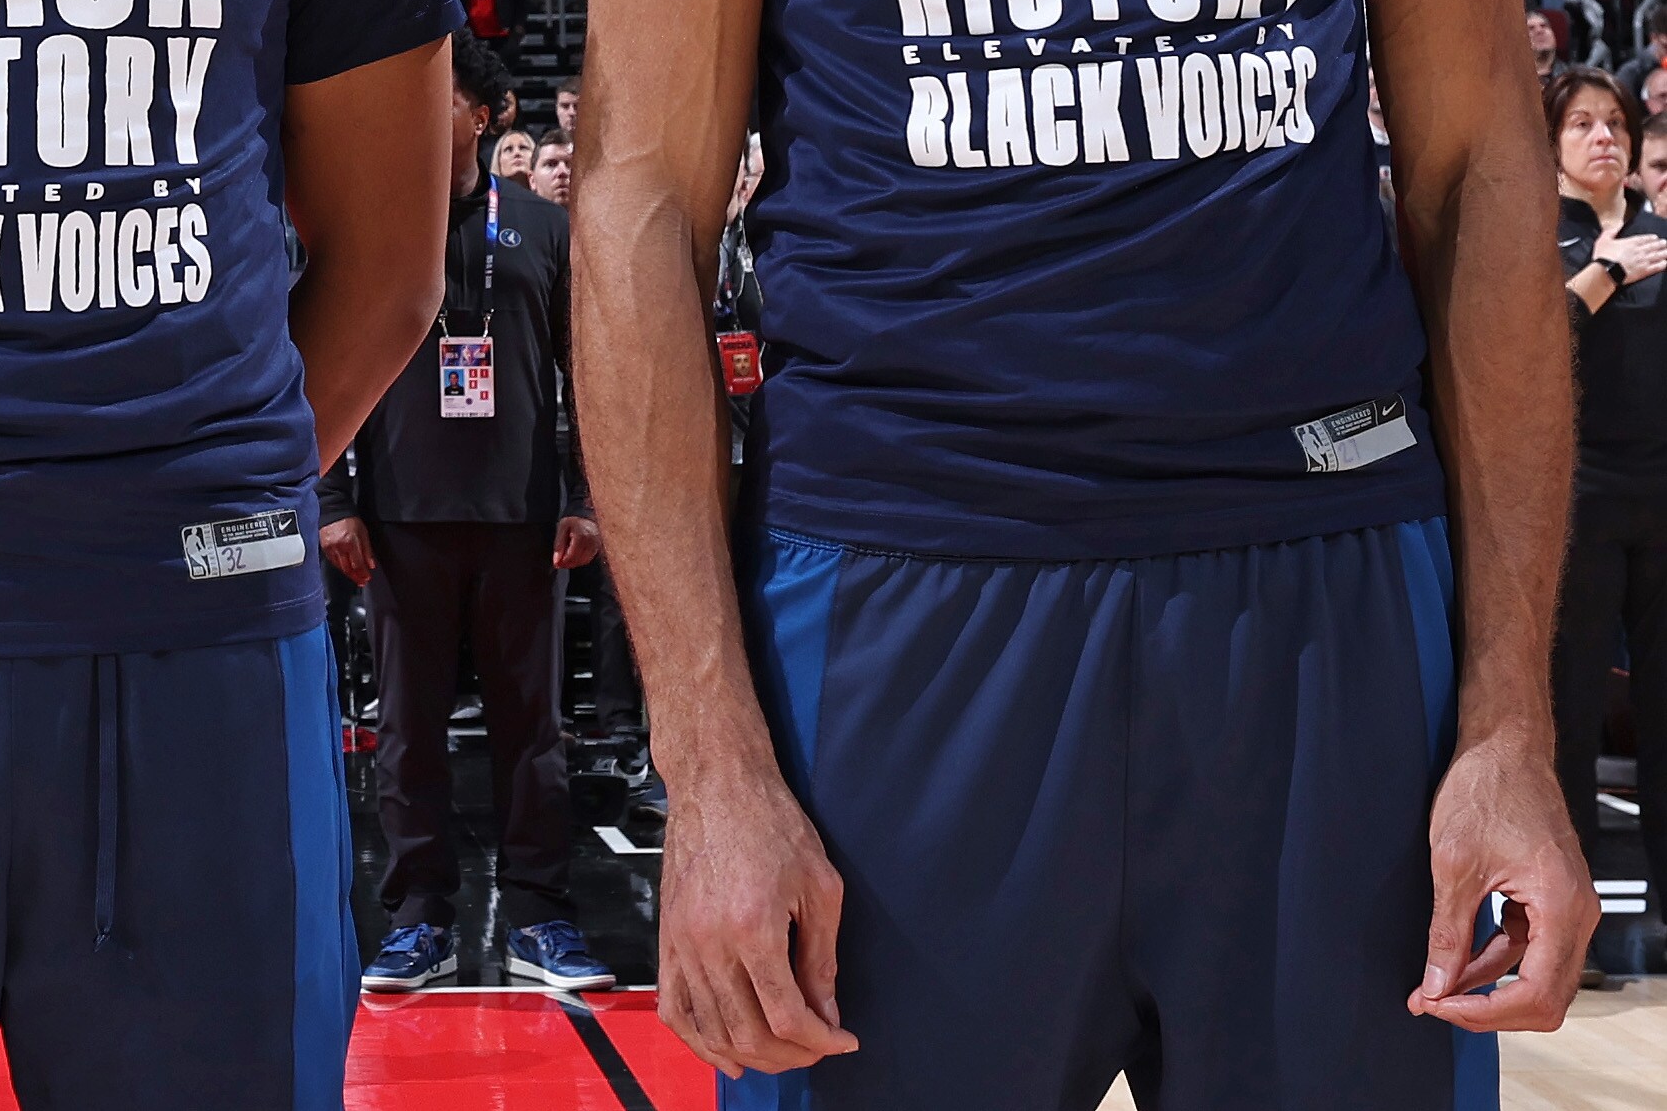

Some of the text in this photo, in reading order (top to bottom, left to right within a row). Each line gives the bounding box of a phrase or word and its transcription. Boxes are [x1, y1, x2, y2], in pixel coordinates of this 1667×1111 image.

[906, 45, 1317, 168] BLACK VOICES
[153, 177, 201, 198] BY
[17, 202, 212, 313] VOICES
[1330, 408, 1372, 428] ENGINEERED
[220, 520, 267, 534] ENGINEERED
[221, 546, 247, 573] 32
